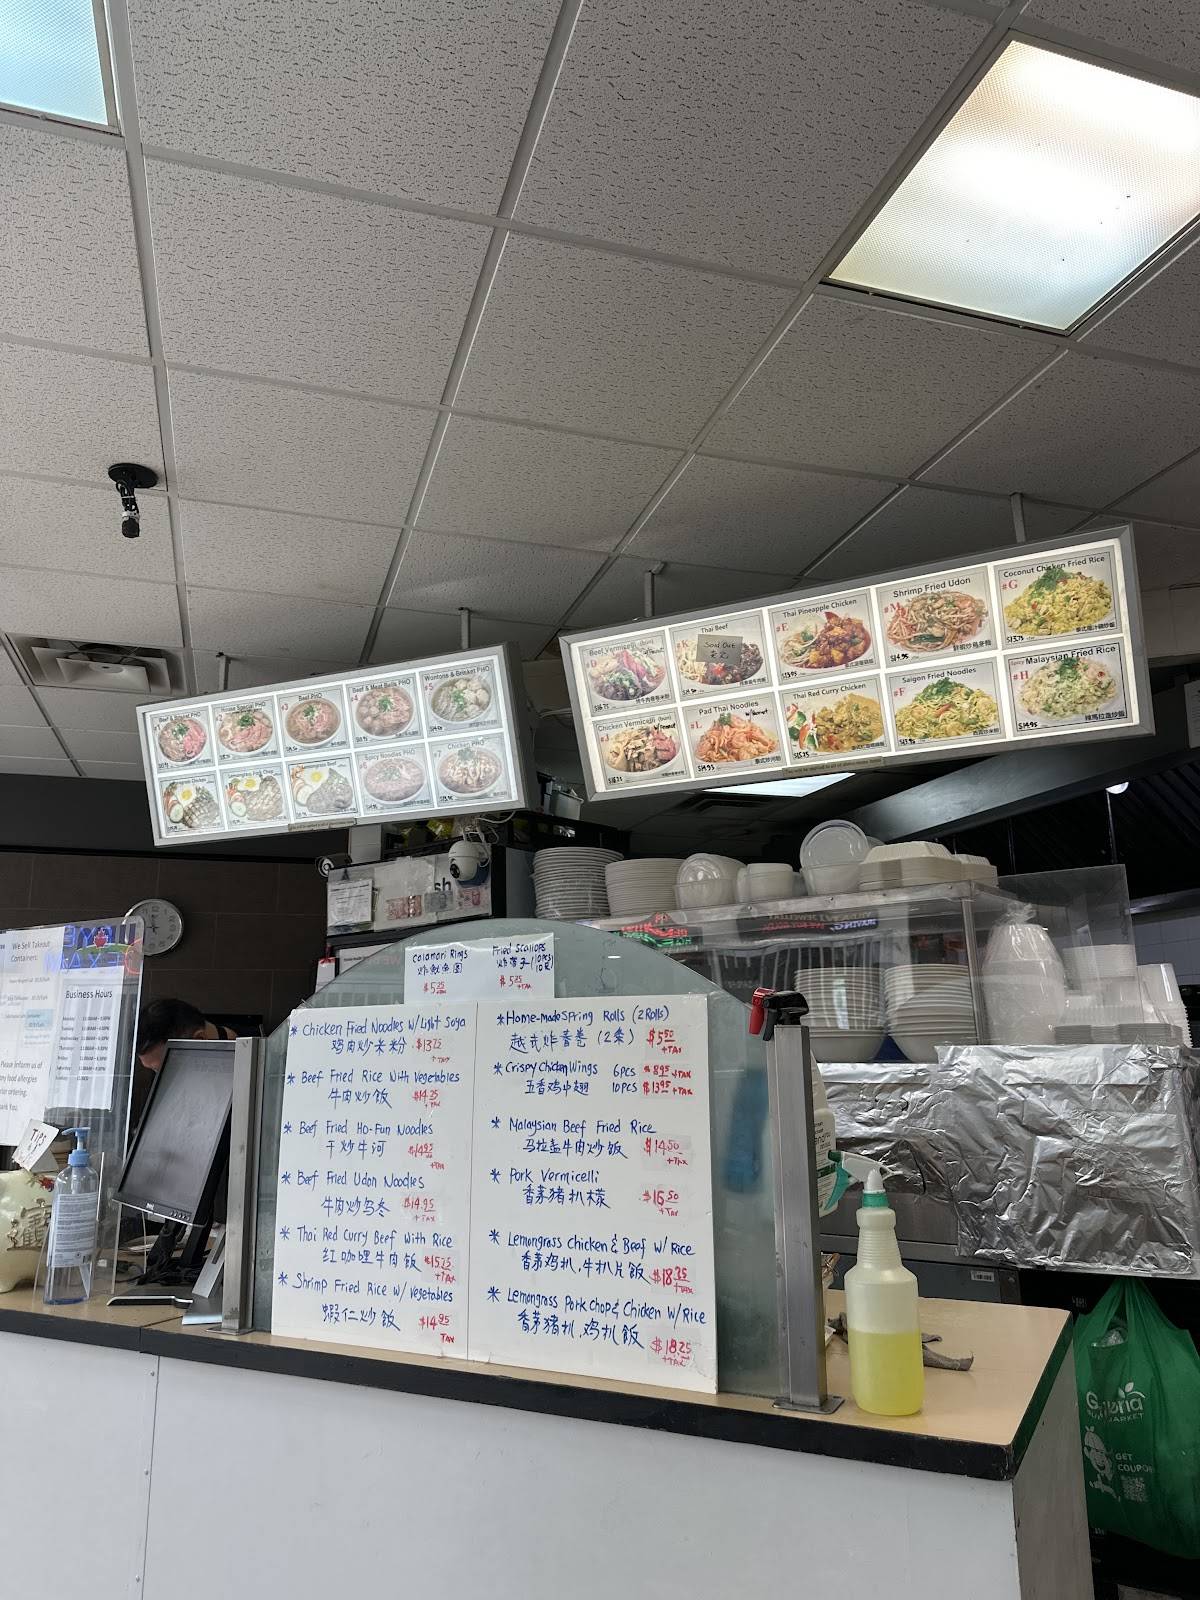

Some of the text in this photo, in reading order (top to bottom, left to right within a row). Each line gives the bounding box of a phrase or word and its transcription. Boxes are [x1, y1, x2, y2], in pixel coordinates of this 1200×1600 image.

[1003, 556, 1105, 578] Coconut Chicken Fried Rice
[893, 577, 971, 598] Shrimp Fried Udon
[798, 605, 830, 614] Pineapple
[831, 599, 857, 609] Chicken
[702, 625, 714, 633] Thai
[1026, 645, 1116, 664] Malaysian Fried Rice
[902, 675, 926, 684] Saigon
[947, 667, 976, 676] Noodles
[793, 692, 806, 700] Thai
[822, 688, 839, 696] Curry
[840, 683, 866, 692] Chicken
[699, 708, 712, 716] Pad
[730, 701, 759, 710] Noodles
[598, 722, 624, 732] Chicken
[624, 717, 656, 728] Vermicelli
[66, 990, 113, 999] Business Hours
[603, 1008, 626, 1022] Rolls
[302, 1022, 342, 1036] Chicken
[347, 1020, 367, 1037] Fried
[371, 1016, 404, 1033] Noodles
[301, 1071, 324, 1088] Beef
[330, 1068, 354, 1084] Fried
[362, 1070, 383, 1084] Rice
[506, 1061, 538, 1078] Crispy
[569, 1062, 598, 1076] Wings
[300, 1120, 318, 1138] Beef
[326, 1120, 348, 1134] Fried
[397, 1118, 434, 1136] Noodles
[509, 1116, 657, 1138] Malaysian Beef Fried Rice
[298, 1170, 425, 1191] Beef Fried Udon Noodles
[510, 1167, 600, 1185] Pork Vermicelli
[296, 1226, 317, 1242] Thai
[323, 1226, 338, 1242] Red
[343, 1228, 368, 1247] Curry
[374, 1230, 398, 1250] Beef
[432, 1232, 454, 1249] Rice
[508, 1231, 562, 1249] Lemongrass
[567, 1234, 609, 1252] Chicken
[623, 1237, 648, 1259] Beef
[671, 1242, 696, 1256] Rice
[292, 1272, 328, 1294] Shrimp
[334, 1278, 360, 1294] Fried
[367, 1280, 387, 1296] Rice
[507, 1287, 558, 1309] Lemongrass
[565, 1294, 586, 1314] Pork
[623, 1298, 661, 1320] Chicken
[1116, 1452, 1133, 1460] GET
